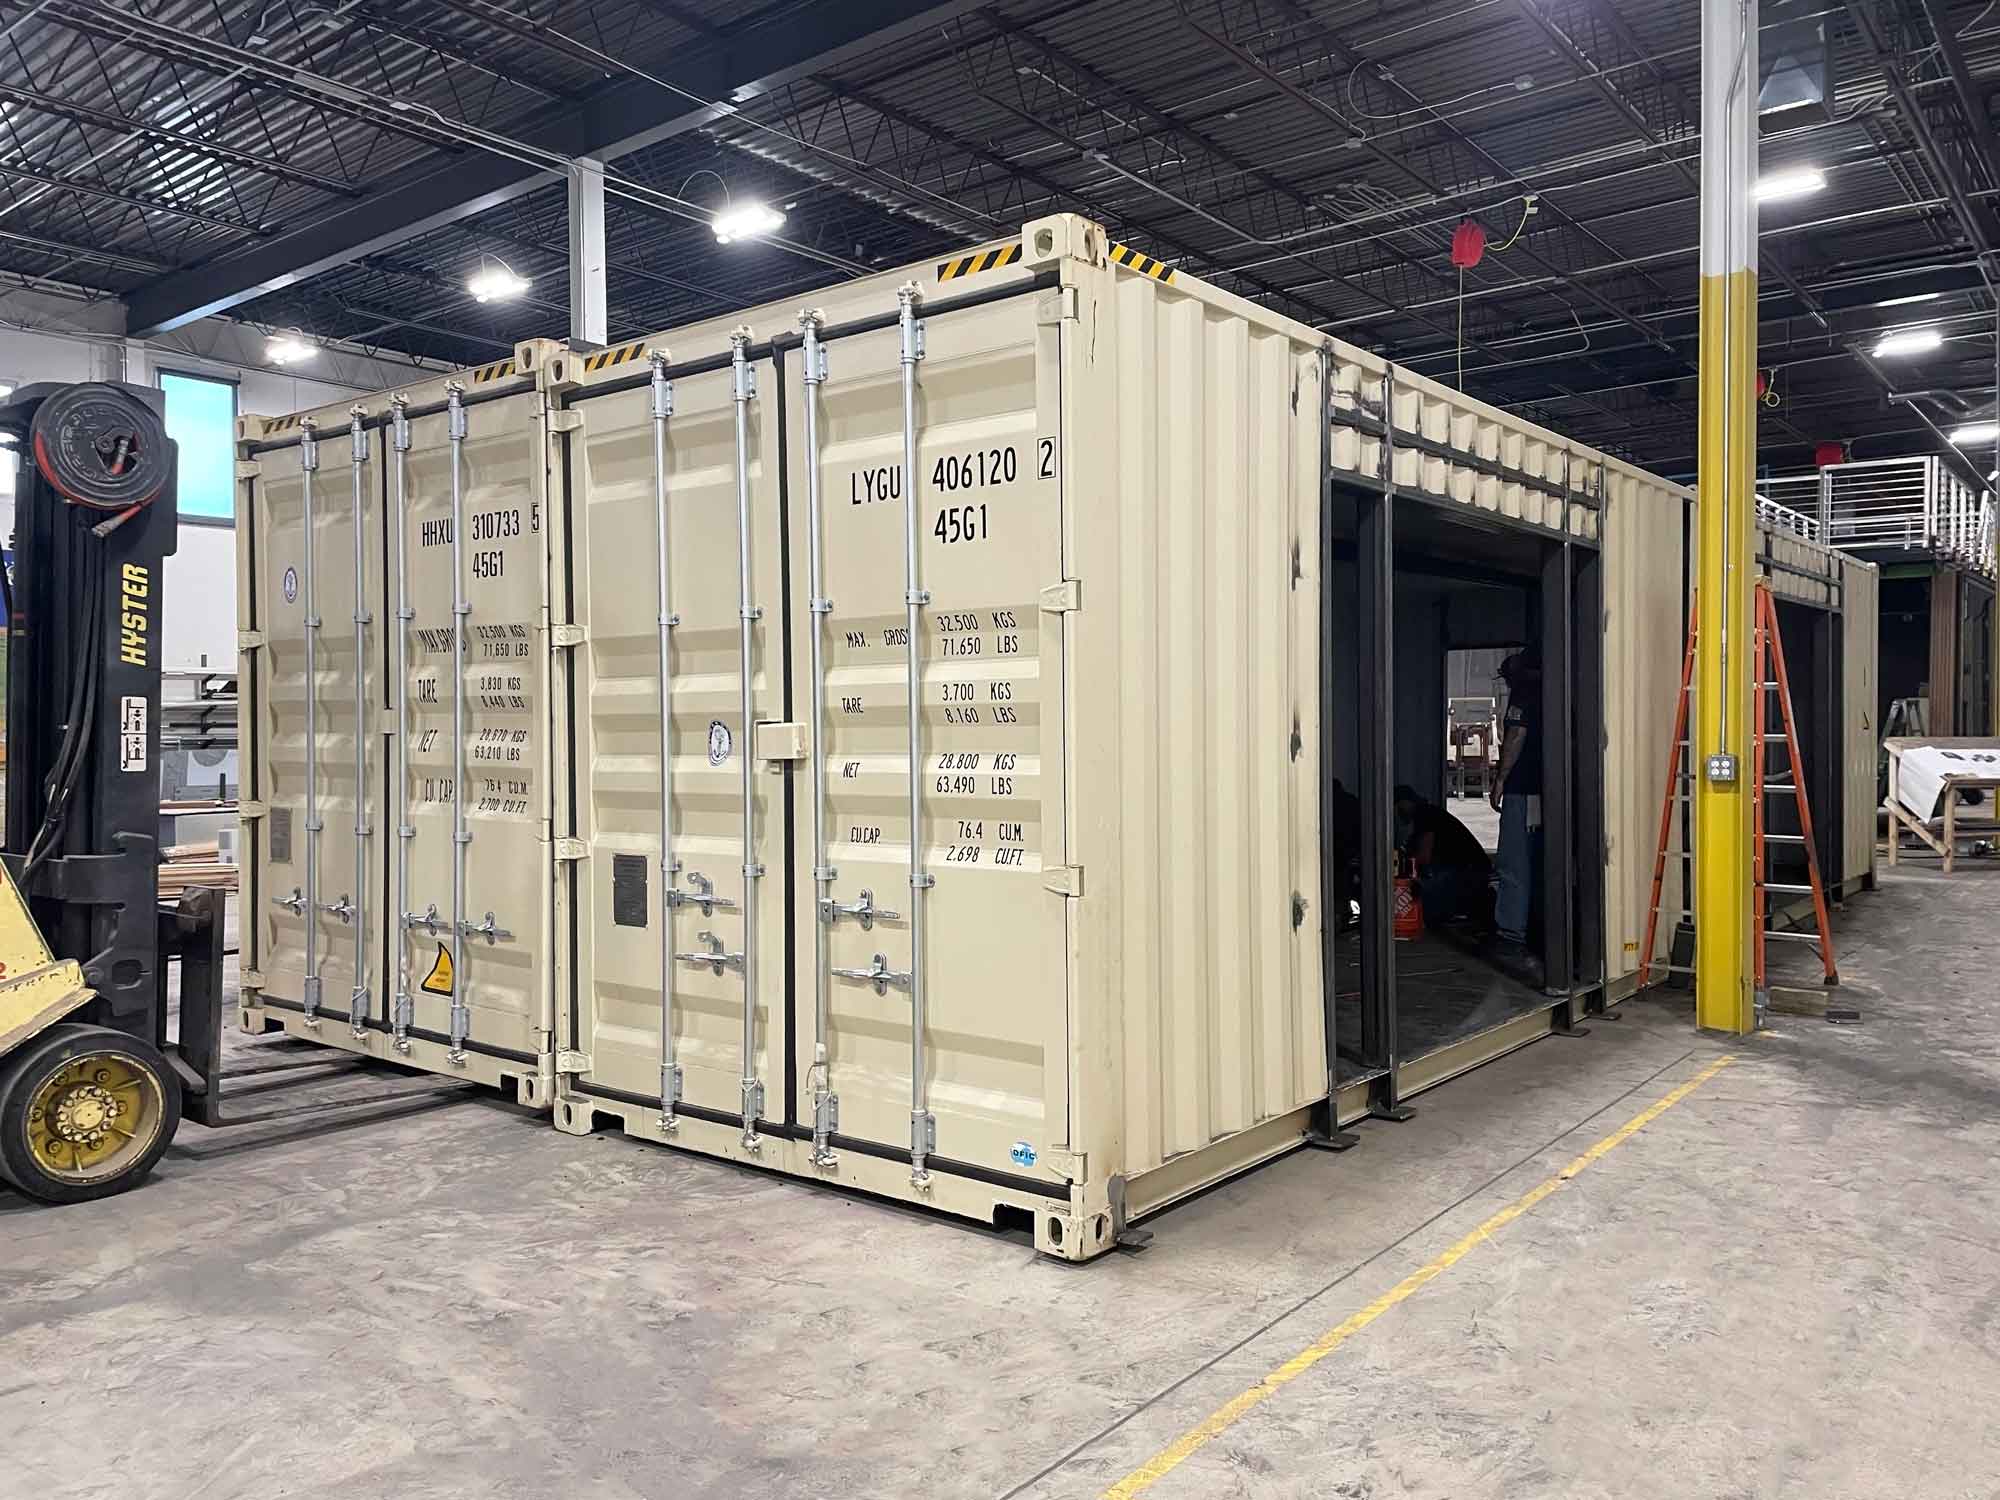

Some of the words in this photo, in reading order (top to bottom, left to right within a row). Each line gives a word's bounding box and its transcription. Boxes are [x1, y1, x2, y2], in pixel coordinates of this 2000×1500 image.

[852, 465, 901, 504] LYGU
[932, 447, 1017, 492] 406120
[1041, 440, 1053, 477] 2
[422, 518, 453, 547] HHXU
[472, 509, 520, 541] 310733
[934, 503, 987, 544] 45G1
[472, 550, 503, 579] 45G1
[120, 563, 149, 667] HYSTER
[937, 614, 979, 632] 32.500
[992, 612, 1017, 629] KGS
[509, 624, 526, 638] KGS
[845, 631, 872, 648] MAX.
[883, 628, 910, 647] GROS
[515, 643, 529, 657] LBS
[942, 637, 981, 656] 71.650
[997, 635, 1018, 653] LBS
[418, 679, 438, 704] TARE
[507, 677, 521, 690] KGS
[942, 683, 974, 701] 3.700
[990, 682, 1012, 700] KGS
[508, 695, 525, 708] LBS
[842, 697, 864, 713] TARE
[945, 708, 979, 724] 8.160
[992, 707, 1017, 723] LBS
[418, 729, 438, 752] NET
[511, 730, 527, 743] KGS
[506, 747, 520, 760] LBS
[938, 753, 979, 770] 28.800
[993, 753, 1017, 770] KGS
[843, 762, 860, 778] NET
[936, 776, 975, 794] 63.490
[991, 777, 1013, 795] LBS
[958, 821, 983, 839] 76.4
[998, 824, 1024, 841] CU.M.
[946, 845, 980, 863] 2.698
[995, 847, 1025, 866] CU.FT.
